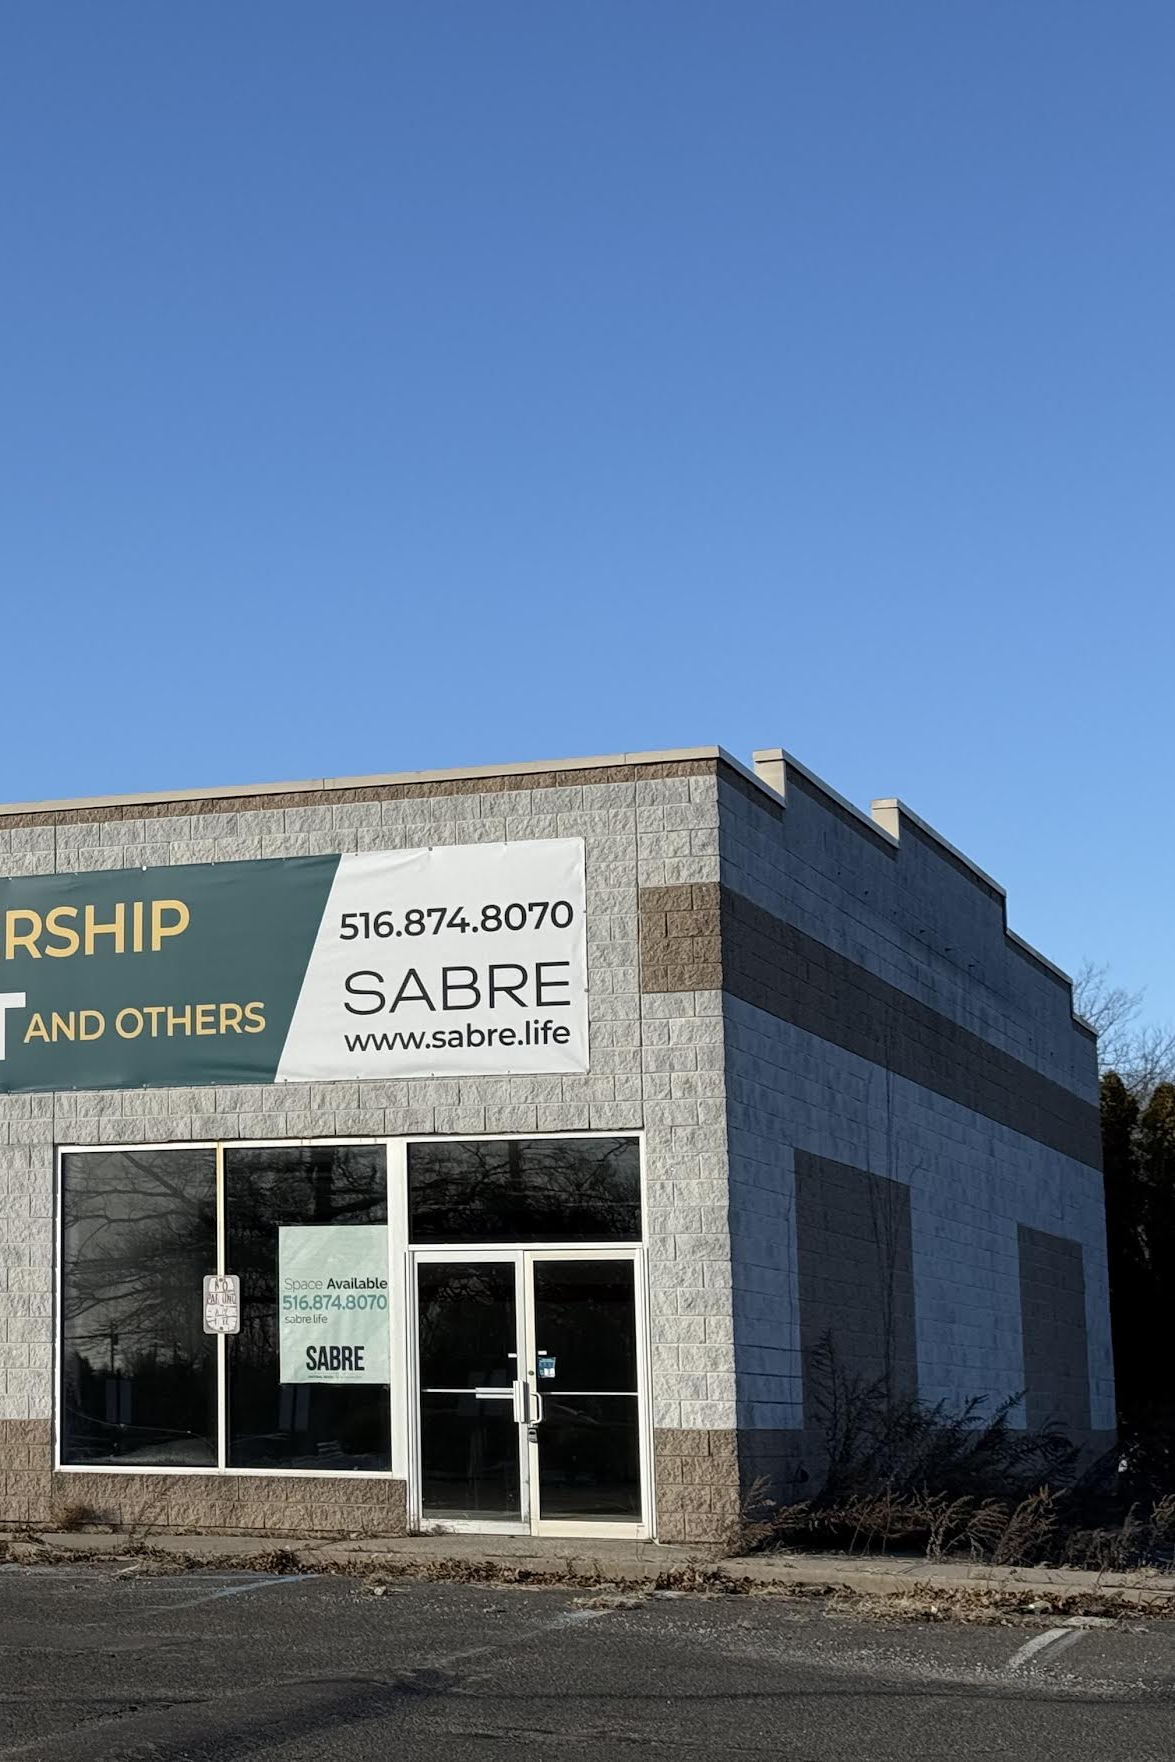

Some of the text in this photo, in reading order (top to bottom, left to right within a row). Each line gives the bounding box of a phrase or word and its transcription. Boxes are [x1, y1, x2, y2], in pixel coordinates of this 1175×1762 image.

[338, 900, 575, 940] 516.874.8070
[343, 960, 572, 1016] SABRE
[23, 1010, 106, 1044] AND
[114, 1001, 267, 1040] OTHERS
[343, 1019, 572, 1053] www.sabre.life
[206, 1293, 237, 1304] PARING
[283, 1277, 388, 1292] Space Available
[282, 1294, 388, 1311] 516.874.8070
[305, 1345, 365, 1371] SABRE
